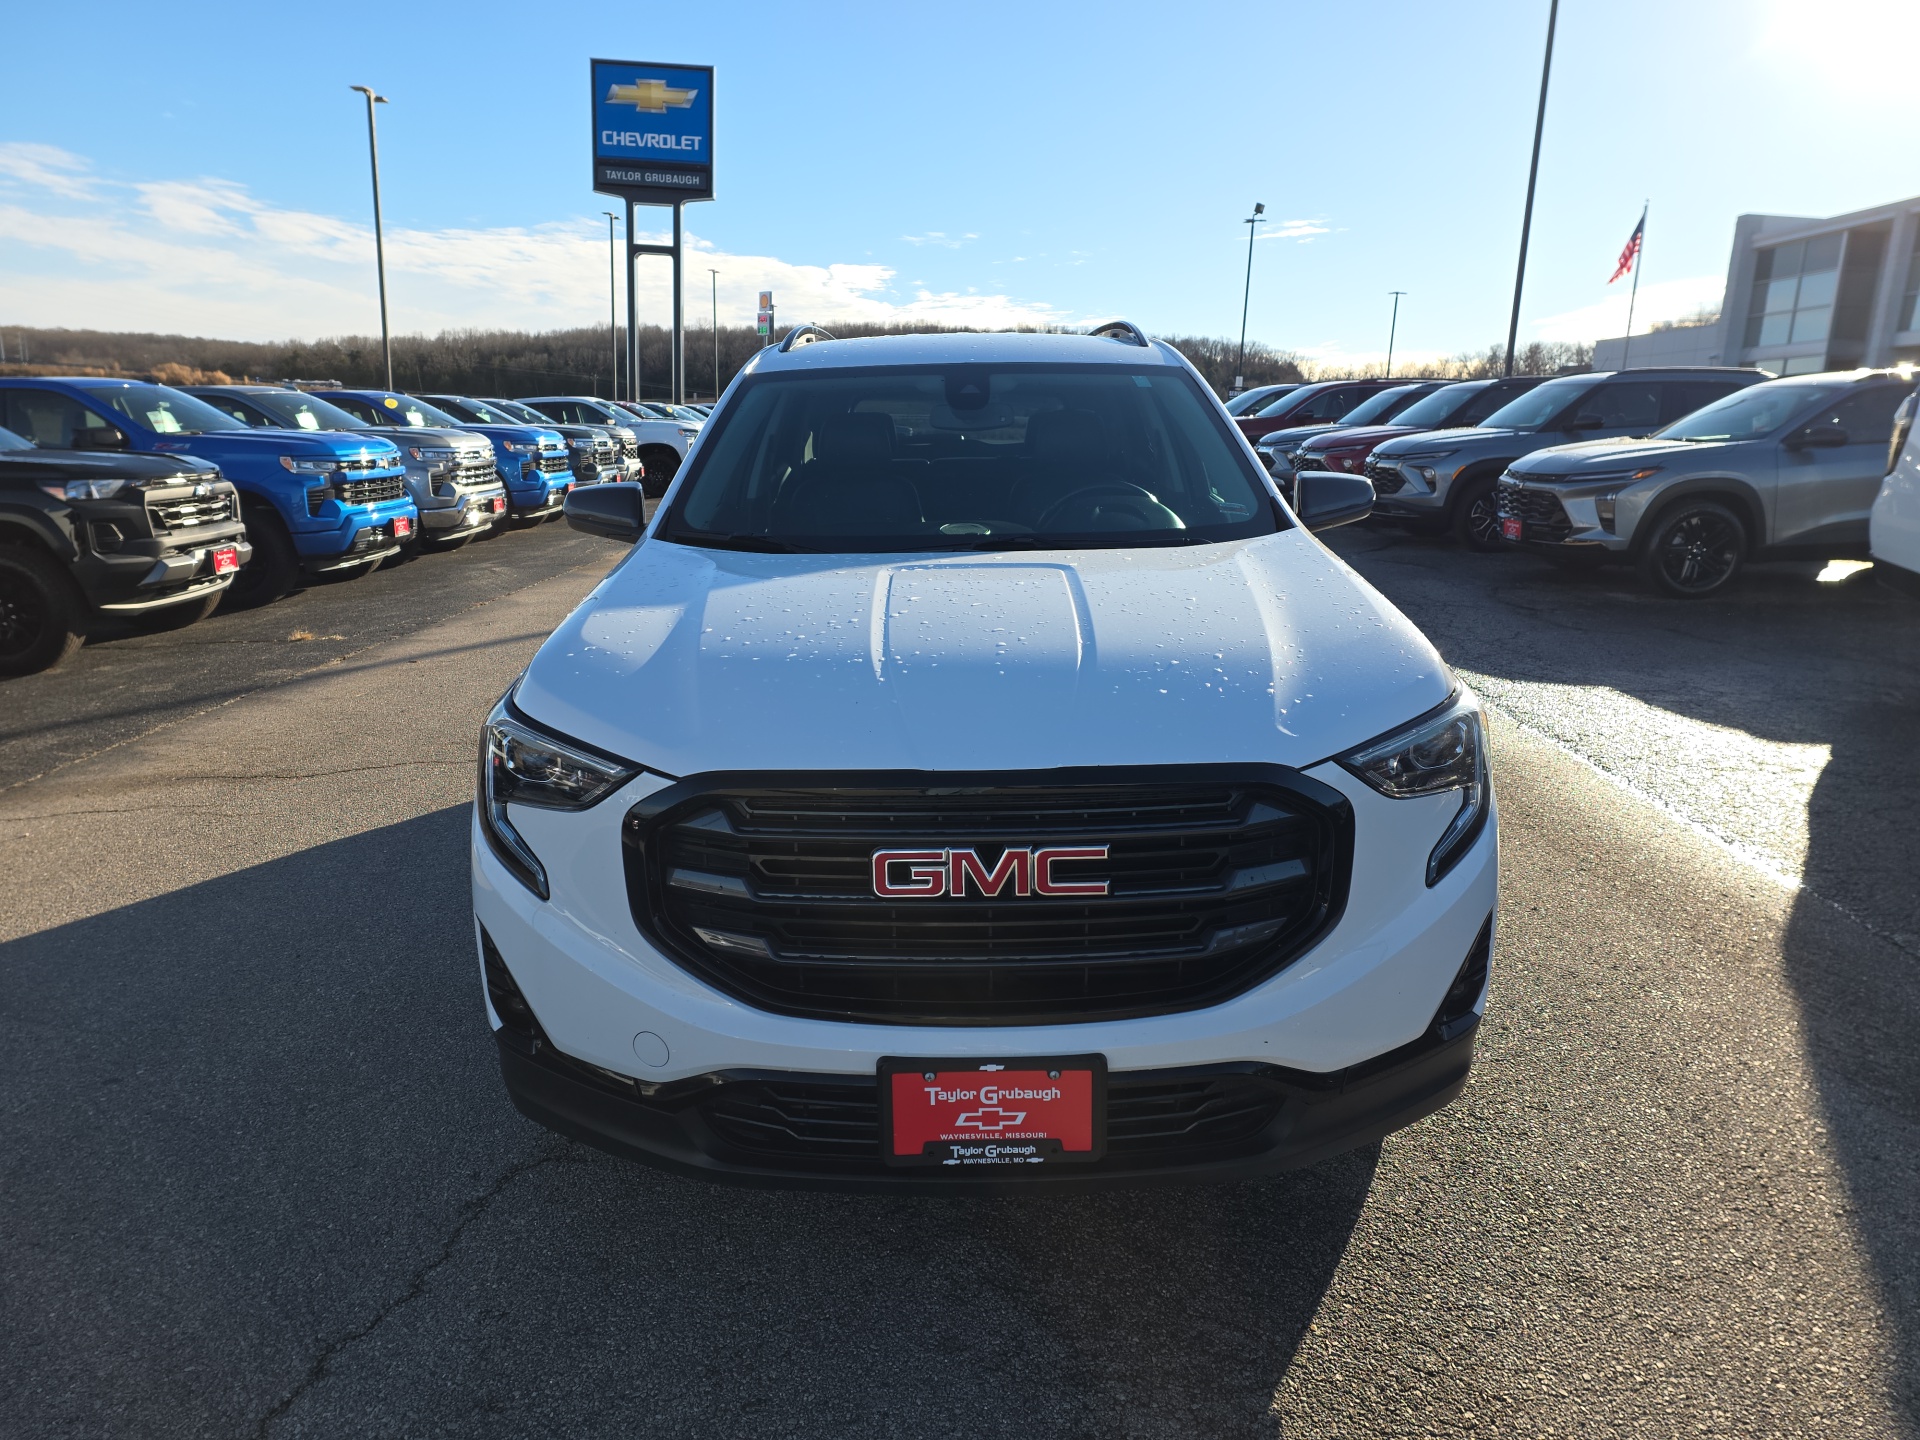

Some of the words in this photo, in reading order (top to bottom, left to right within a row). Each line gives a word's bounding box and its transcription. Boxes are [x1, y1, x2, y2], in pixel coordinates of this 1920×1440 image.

[602, 131, 702, 150] CHEVROLET
[605, 170, 641, 181] TAYLOR
[645, 173, 700, 184] GRUBAUGH
[872, 844, 1110, 898] GMC
[924, 1087, 976, 1106] Taylor
[979, 1086, 1061, 1105] Grubaugh
[940, 1132, 1003, 1140] WAYNESVILLE,
[950, 1145, 984, 1158] Taylor
[984, 1144, 1036, 1158] Grubaugh
